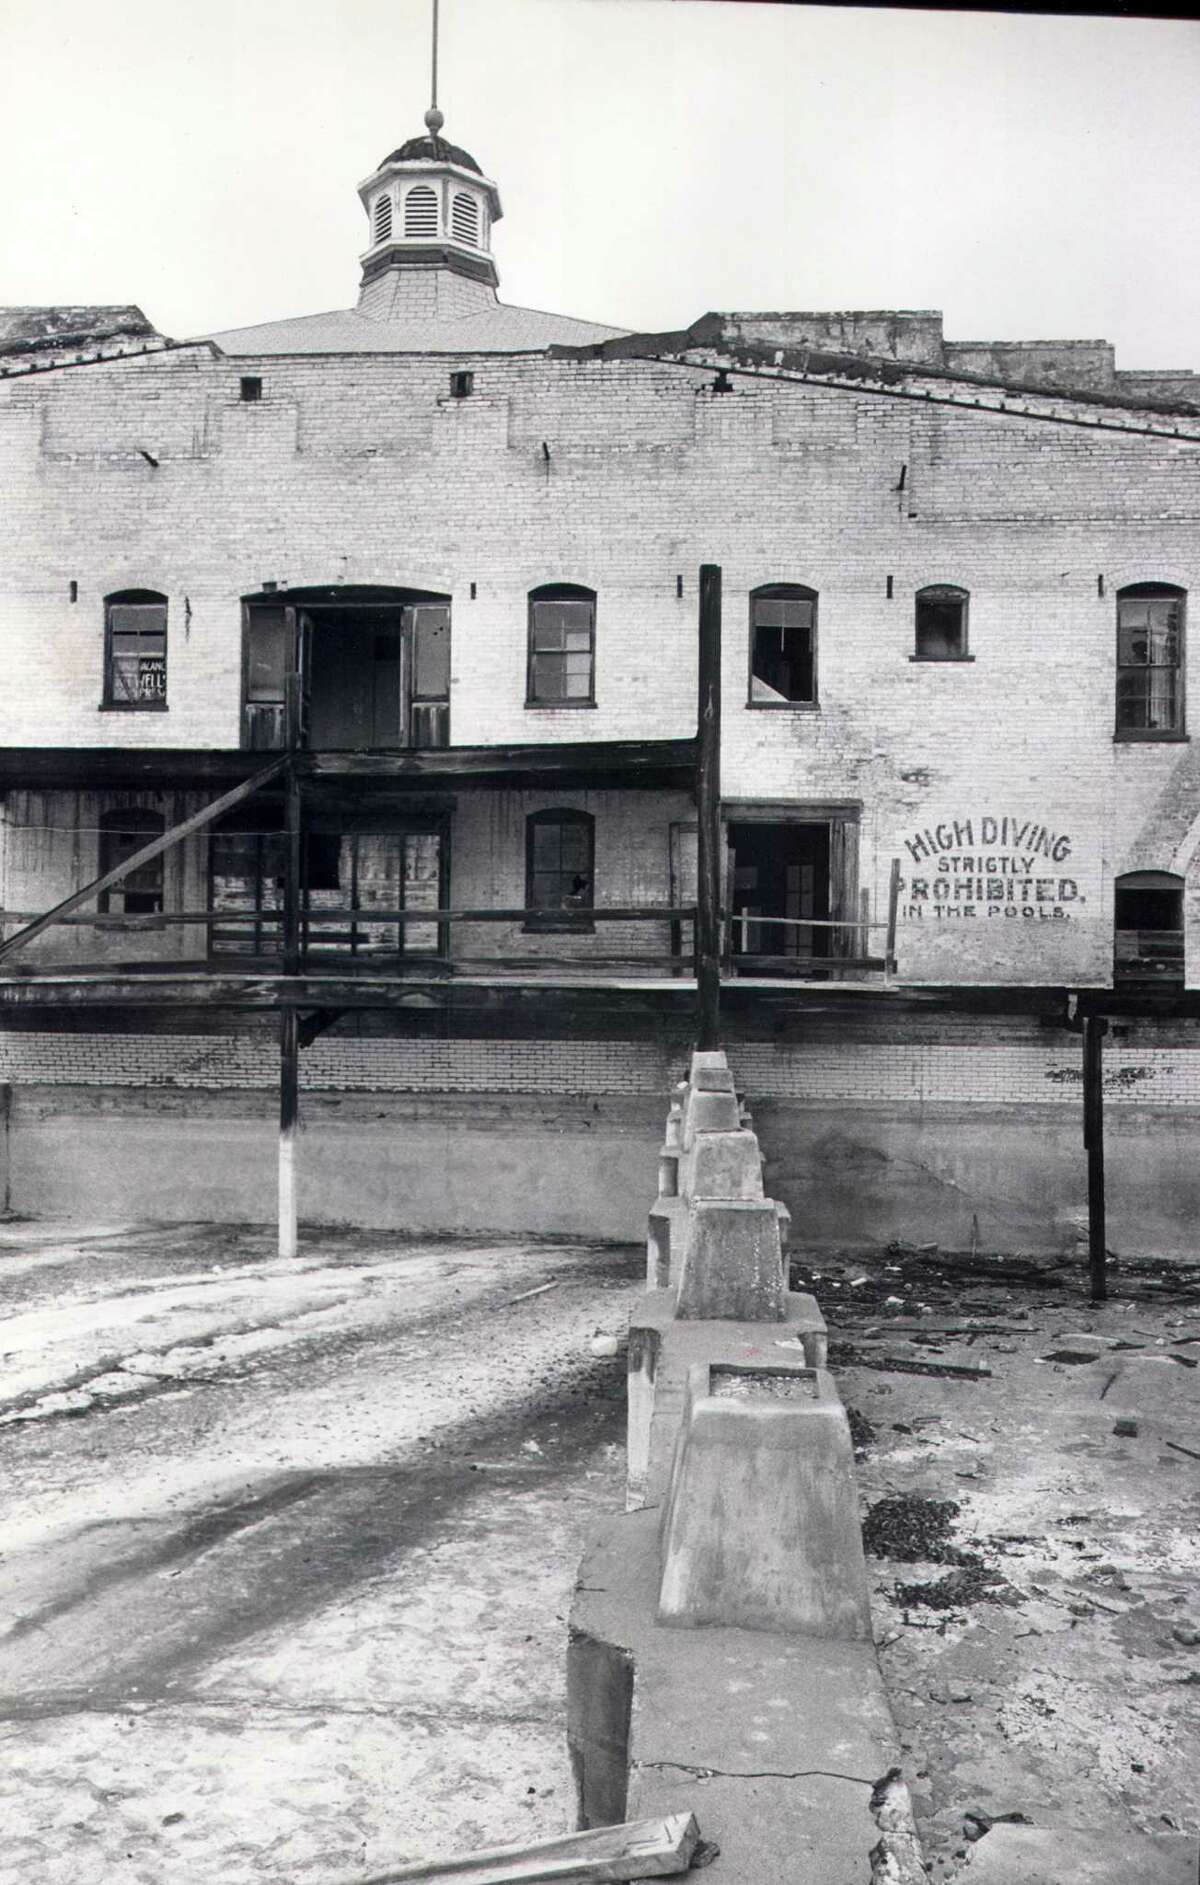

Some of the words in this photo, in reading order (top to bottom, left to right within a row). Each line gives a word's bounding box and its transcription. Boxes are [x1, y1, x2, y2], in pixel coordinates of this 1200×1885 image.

[904, 818, 974, 863] HIGH
[981, 816, 1072, 862] DIVING
[902, 905, 922, 917] IN
[933, 905, 976, 917] THE
[988, 905, 1071, 918] POOLS.
